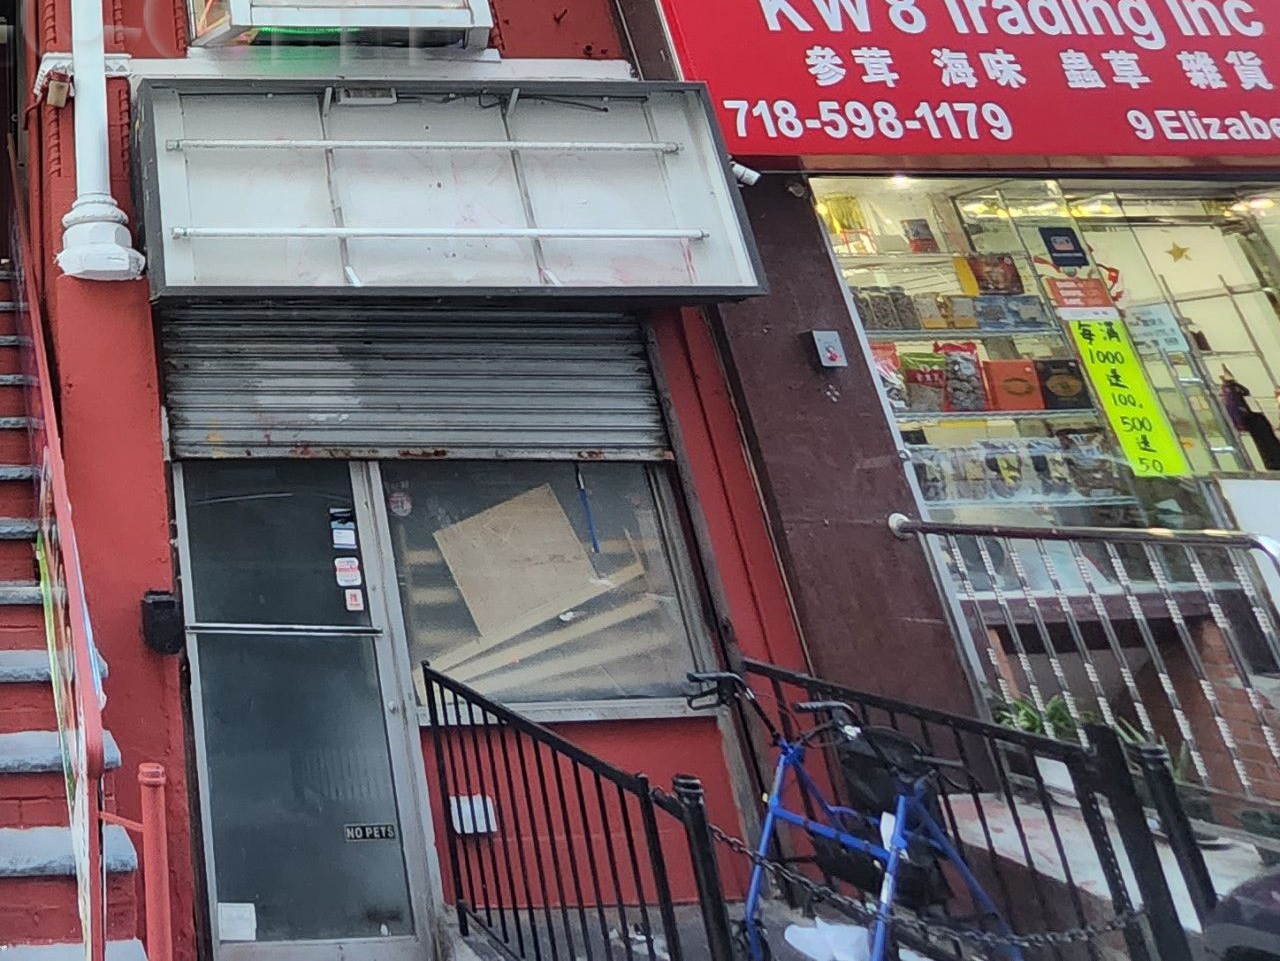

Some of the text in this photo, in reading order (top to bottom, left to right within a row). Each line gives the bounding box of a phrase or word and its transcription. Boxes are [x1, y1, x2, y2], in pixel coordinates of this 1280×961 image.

[930, 47, 1028, 90] 海味
[723, 99, 1013, 142] 718-598-1179
[1126, 109, 1156, 142] 9
[1089, 349, 1124, 365] 1000
[1120, 416, 1152, 432] 500
[1138, 458, 1163, 473] 50
[346, 825, 395, 839] NO PETS
